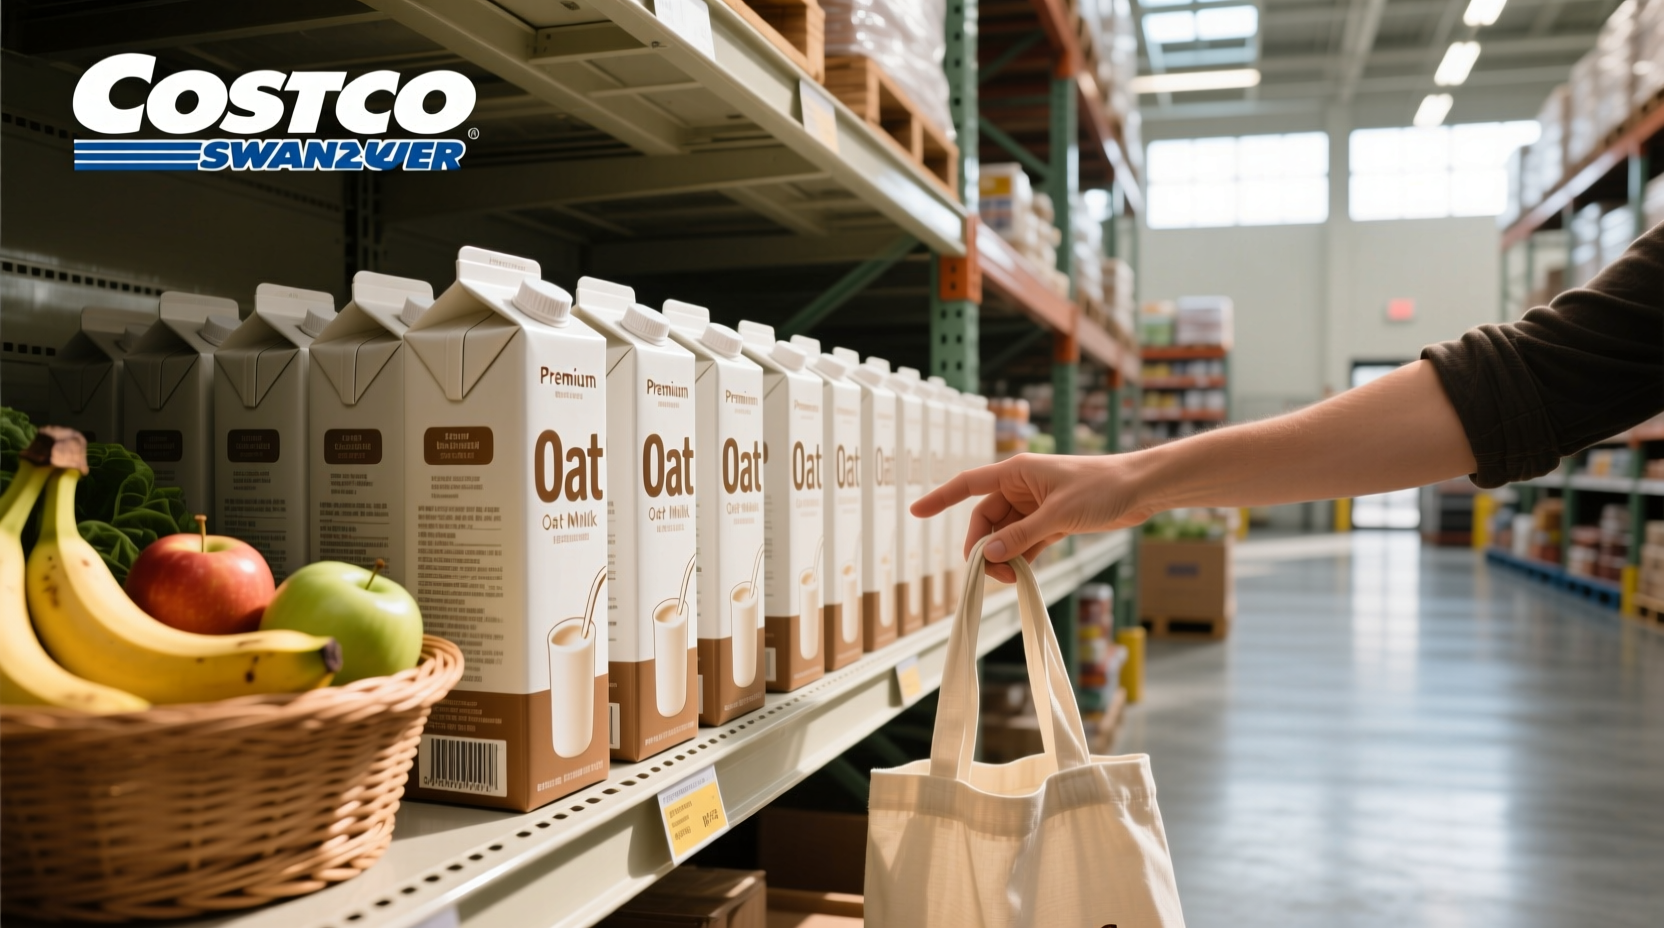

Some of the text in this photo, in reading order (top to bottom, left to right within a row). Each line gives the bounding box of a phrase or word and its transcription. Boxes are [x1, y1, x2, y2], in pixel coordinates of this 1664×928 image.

[540, 366, 597, 389] Premium
[534, 429, 603, 504] Oat
[642, 433, 694, 498] Oat
[722, 437, 762, 495] Oat
[792, 441, 822, 491] Oat
[542, 513, 564, 531] Oat
